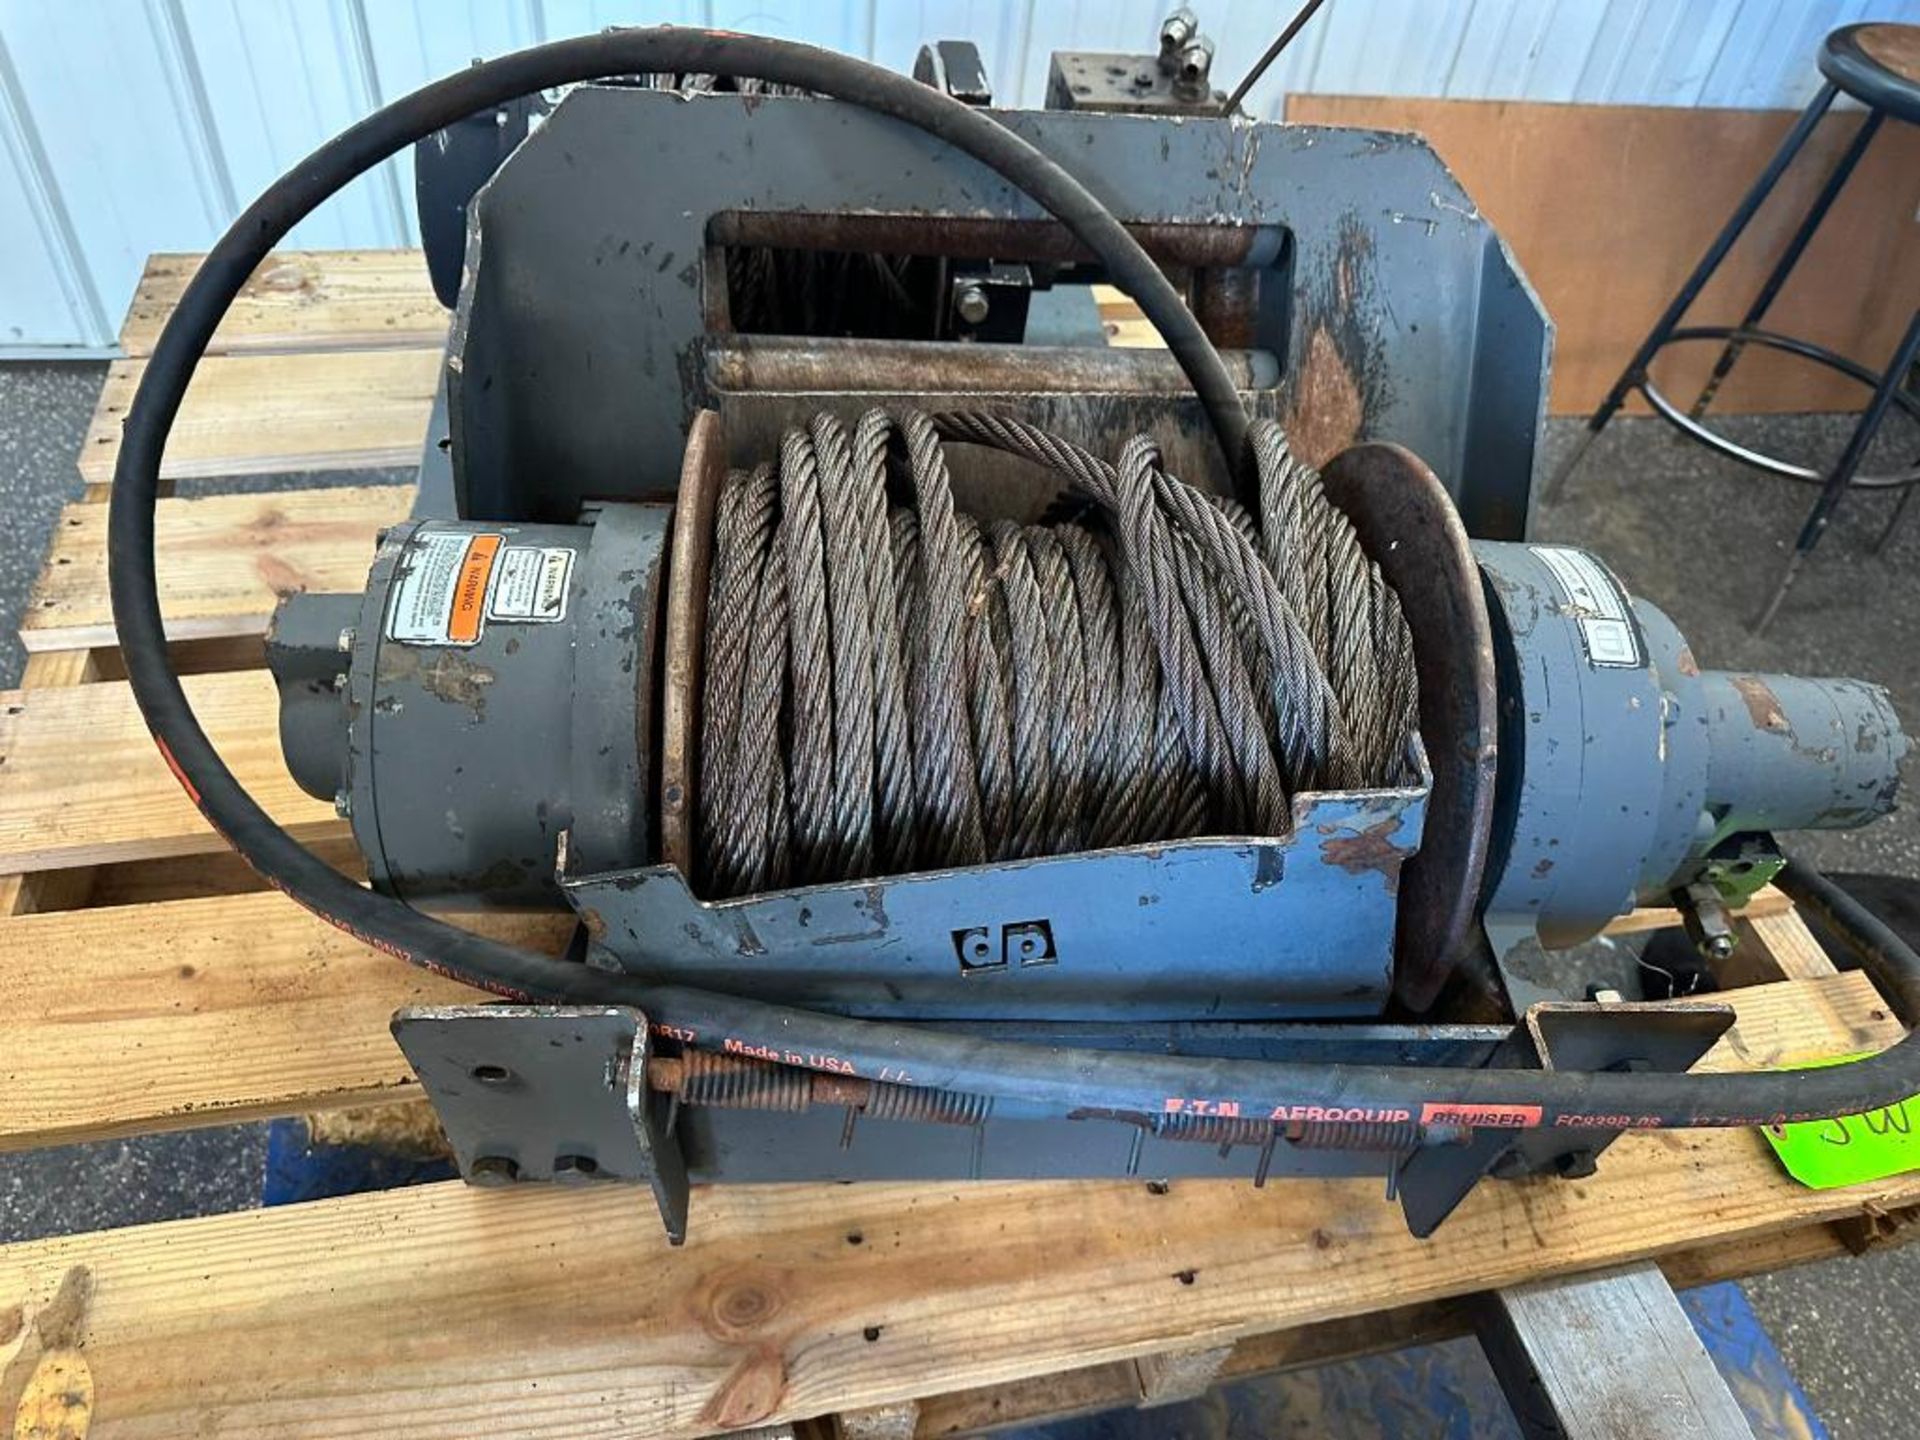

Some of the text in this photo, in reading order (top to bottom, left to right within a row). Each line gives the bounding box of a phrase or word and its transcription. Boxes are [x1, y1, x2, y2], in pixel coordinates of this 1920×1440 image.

[724, 1038, 780, 1062] Made
[784, 1050, 803, 1065] in
[809, 1056, 855, 1074] USA
[1432, 1111, 1527, 1126] BRUISER
